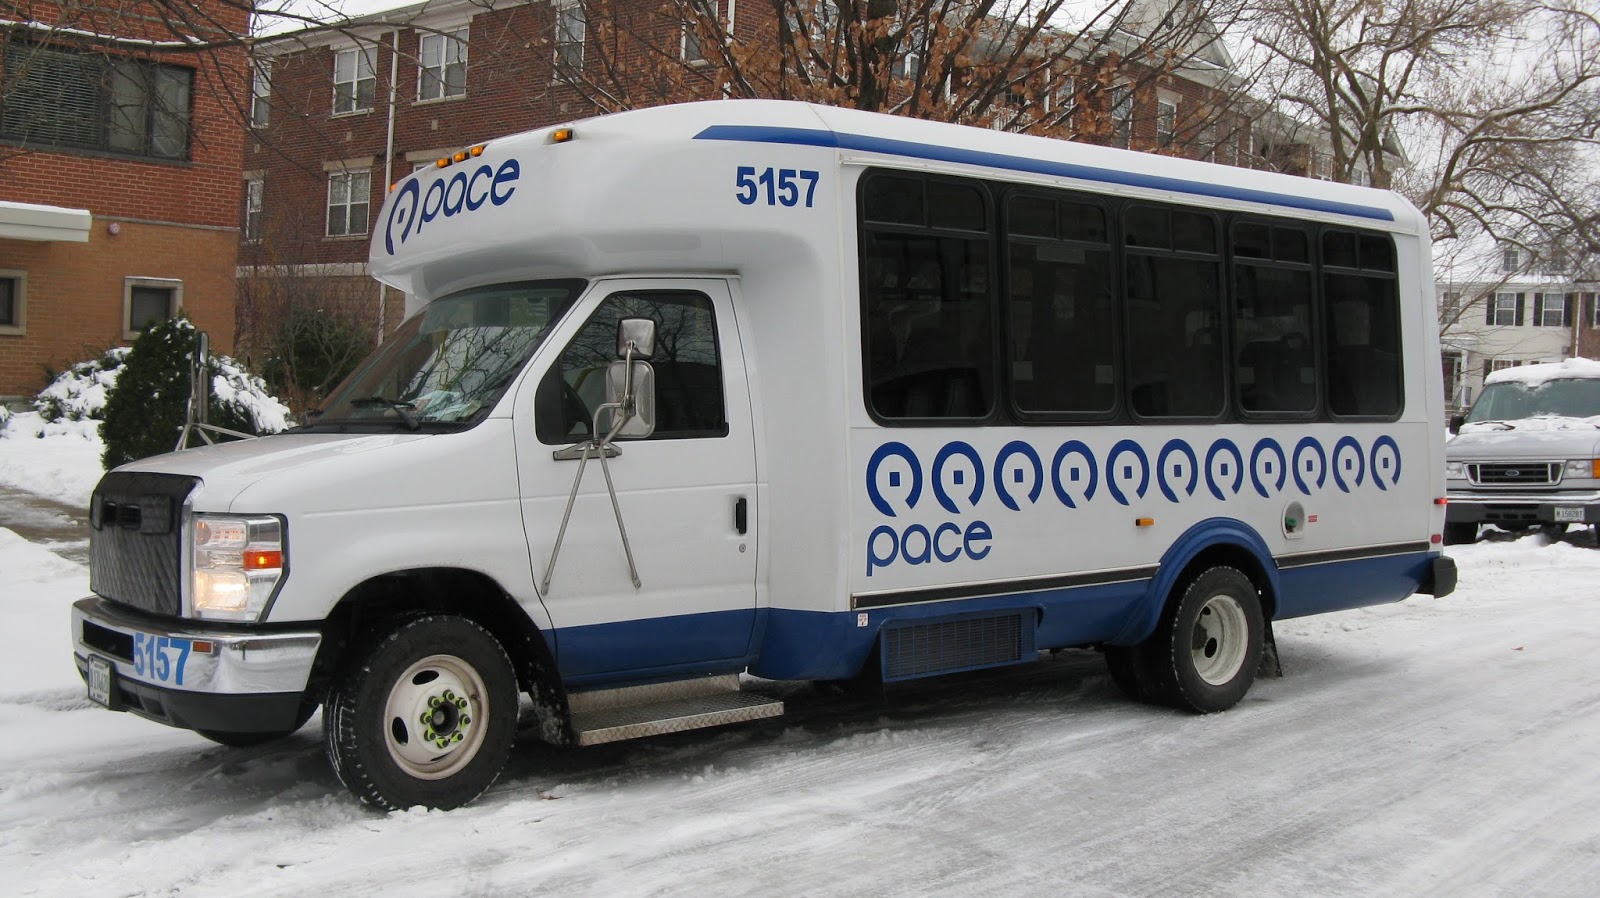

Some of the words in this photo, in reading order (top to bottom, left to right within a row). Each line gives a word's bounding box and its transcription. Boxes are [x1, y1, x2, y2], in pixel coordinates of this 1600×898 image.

[416, 158, 520, 235] pace
[736, 166, 820, 208] 5157
[866, 520, 993, 577] pace
[134, 632, 191, 685] 5157
